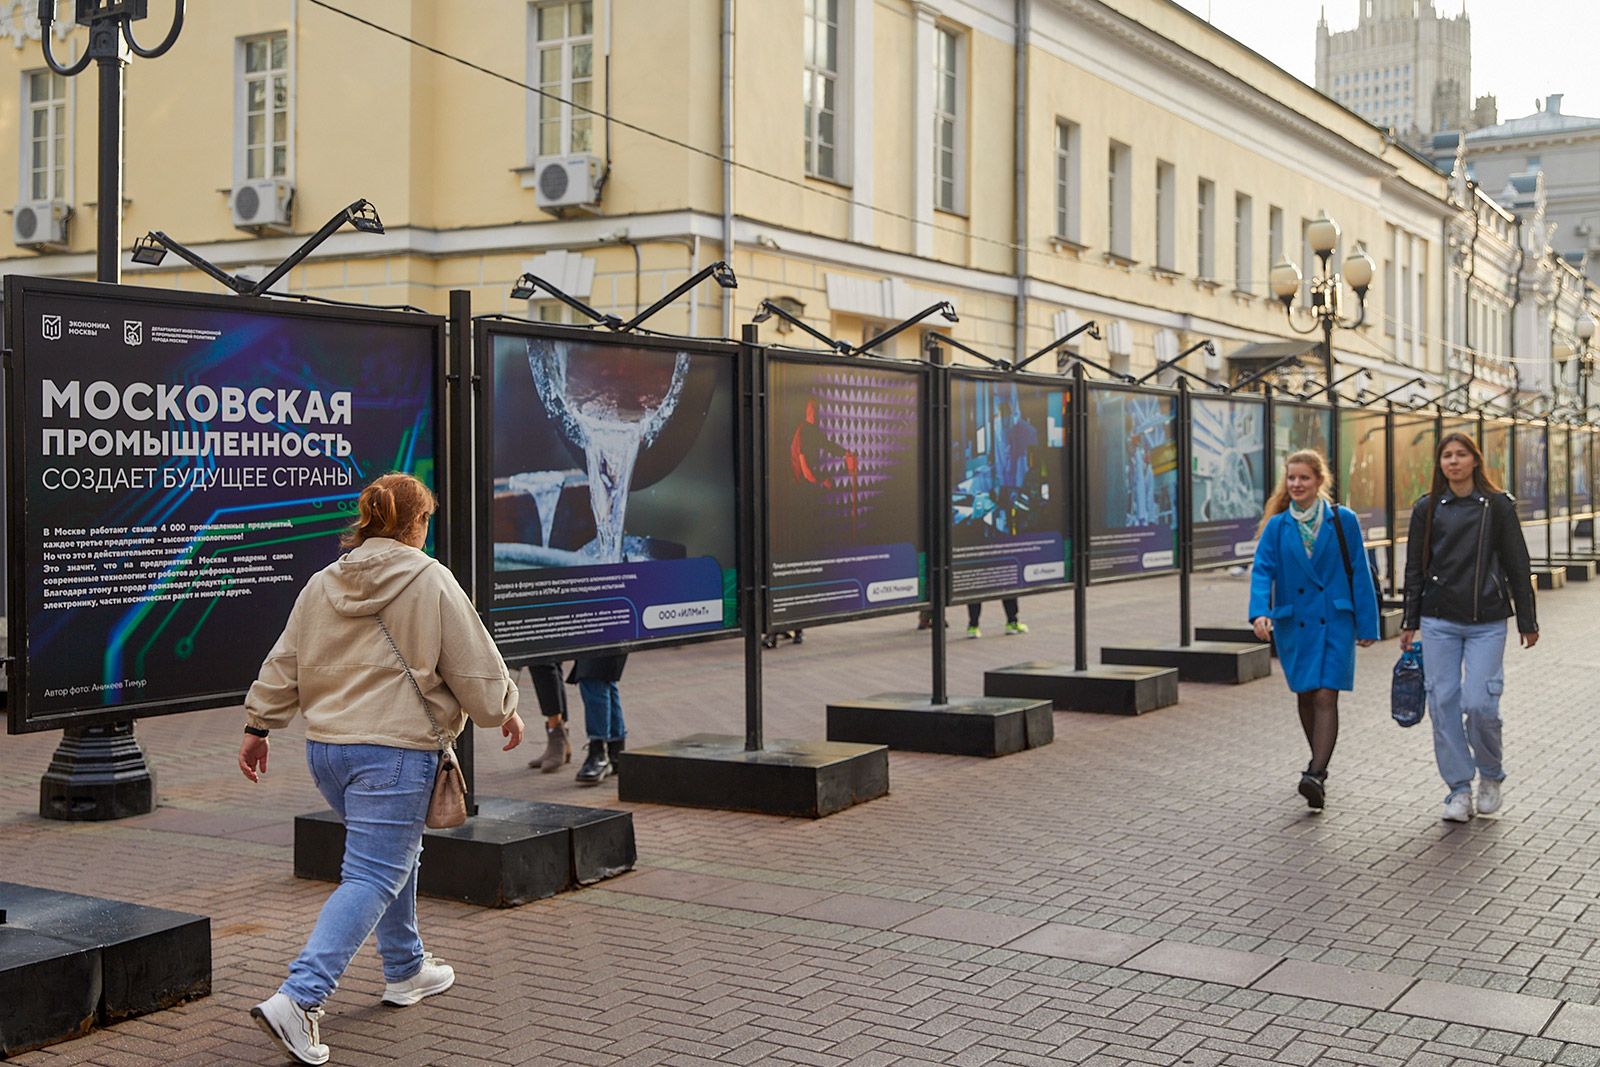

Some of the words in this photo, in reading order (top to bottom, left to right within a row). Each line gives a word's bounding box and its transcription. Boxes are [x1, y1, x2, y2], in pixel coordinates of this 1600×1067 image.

[69, 320, 110, 330] ЭКОНОМИКА
[42, 379, 352, 425] МОСКОВСКАЯ
[42, 428, 352, 458] ПРОМЫШЛЕННОСТЬ
[42, 467, 157, 493] СОЗДАЕТ
[163, 467, 266, 492] БУДУЩЕЕ
[273, 466, 352, 487] СТРАНЫ
[44, 528, 50, 536] В
[54, 528, 86, 536] Москве
[90, 526, 128, 536] работают
[161, 524, 166, 532] 4
[190, 523, 244, 532] промышленных
[248, 520, 293, 529] предприятий,
[43, 541, 75, 549] каждое
[76, 540, 103, 548] третье
[104, 538, 154, 547] предприятие
[163, 533, 244, 543] высокотехнологичное!
[94, 549, 163, 559] действительности
[165, 546, 193, 555] значит?
[44, 565, 60, 573] Это
[67, 564, 96, 572] значит,
[140, 559, 193, 568] предприятиях
[199, 556, 227, 565] Москвы
[233, 554, 267, 563] внедрены
[43, 576, 99, 586] современные
[100, 573, 147, 582] технологии:
[158, 570, 188, 578] роботов
[200, 567, 235, 576] цифровых
[236, 565, 274, 574] двойников.
[44, 588, 87, 597] Благодаря
[120, 584, 146, 593] городе
[148, 581, 190, 590] производят
[192, 579, 226, 588] продукты
[258, 574, 293, 583] лекарства,
[43, 600, 98, 610] электронику,
[123, 594, 171, 603] космических
[173, 593, 193, 601] ракет
[226, 589, 252, 597] другое.
[659, 610, 676, 620] ООО
[44, 688, 68, 698] Автор
[69, 686, 90, 696] фото:
[124, 679, 147, 688] Тимур
